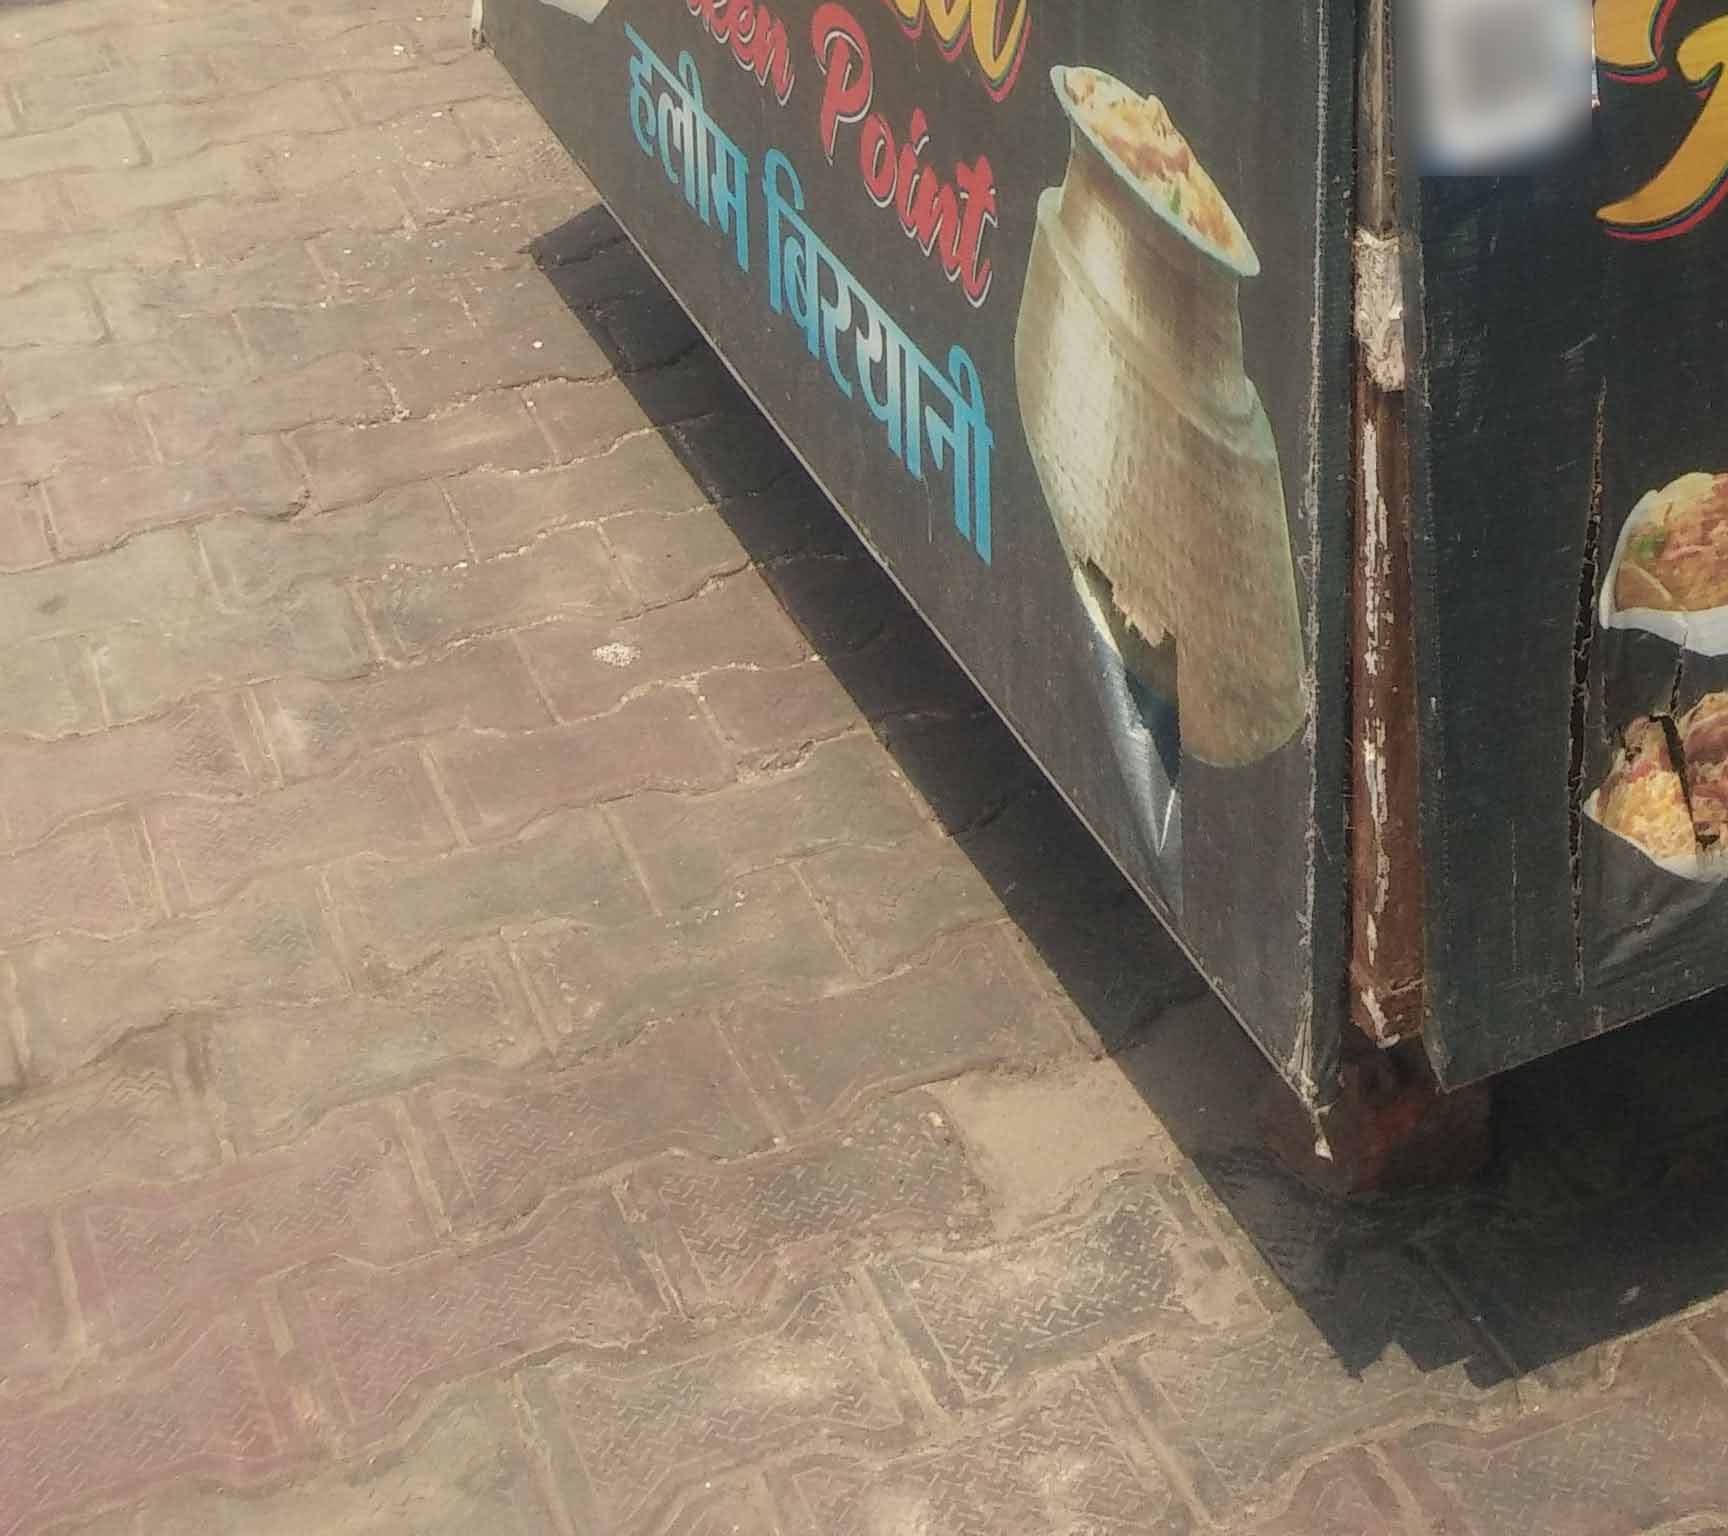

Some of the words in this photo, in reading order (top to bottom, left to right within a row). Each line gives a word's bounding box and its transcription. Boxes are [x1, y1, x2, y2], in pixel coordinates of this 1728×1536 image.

[624, 22, 750, 273] हलीम
[763, 148, 994, 566] बिरयानी
[811, 2, 998, 308] Point
